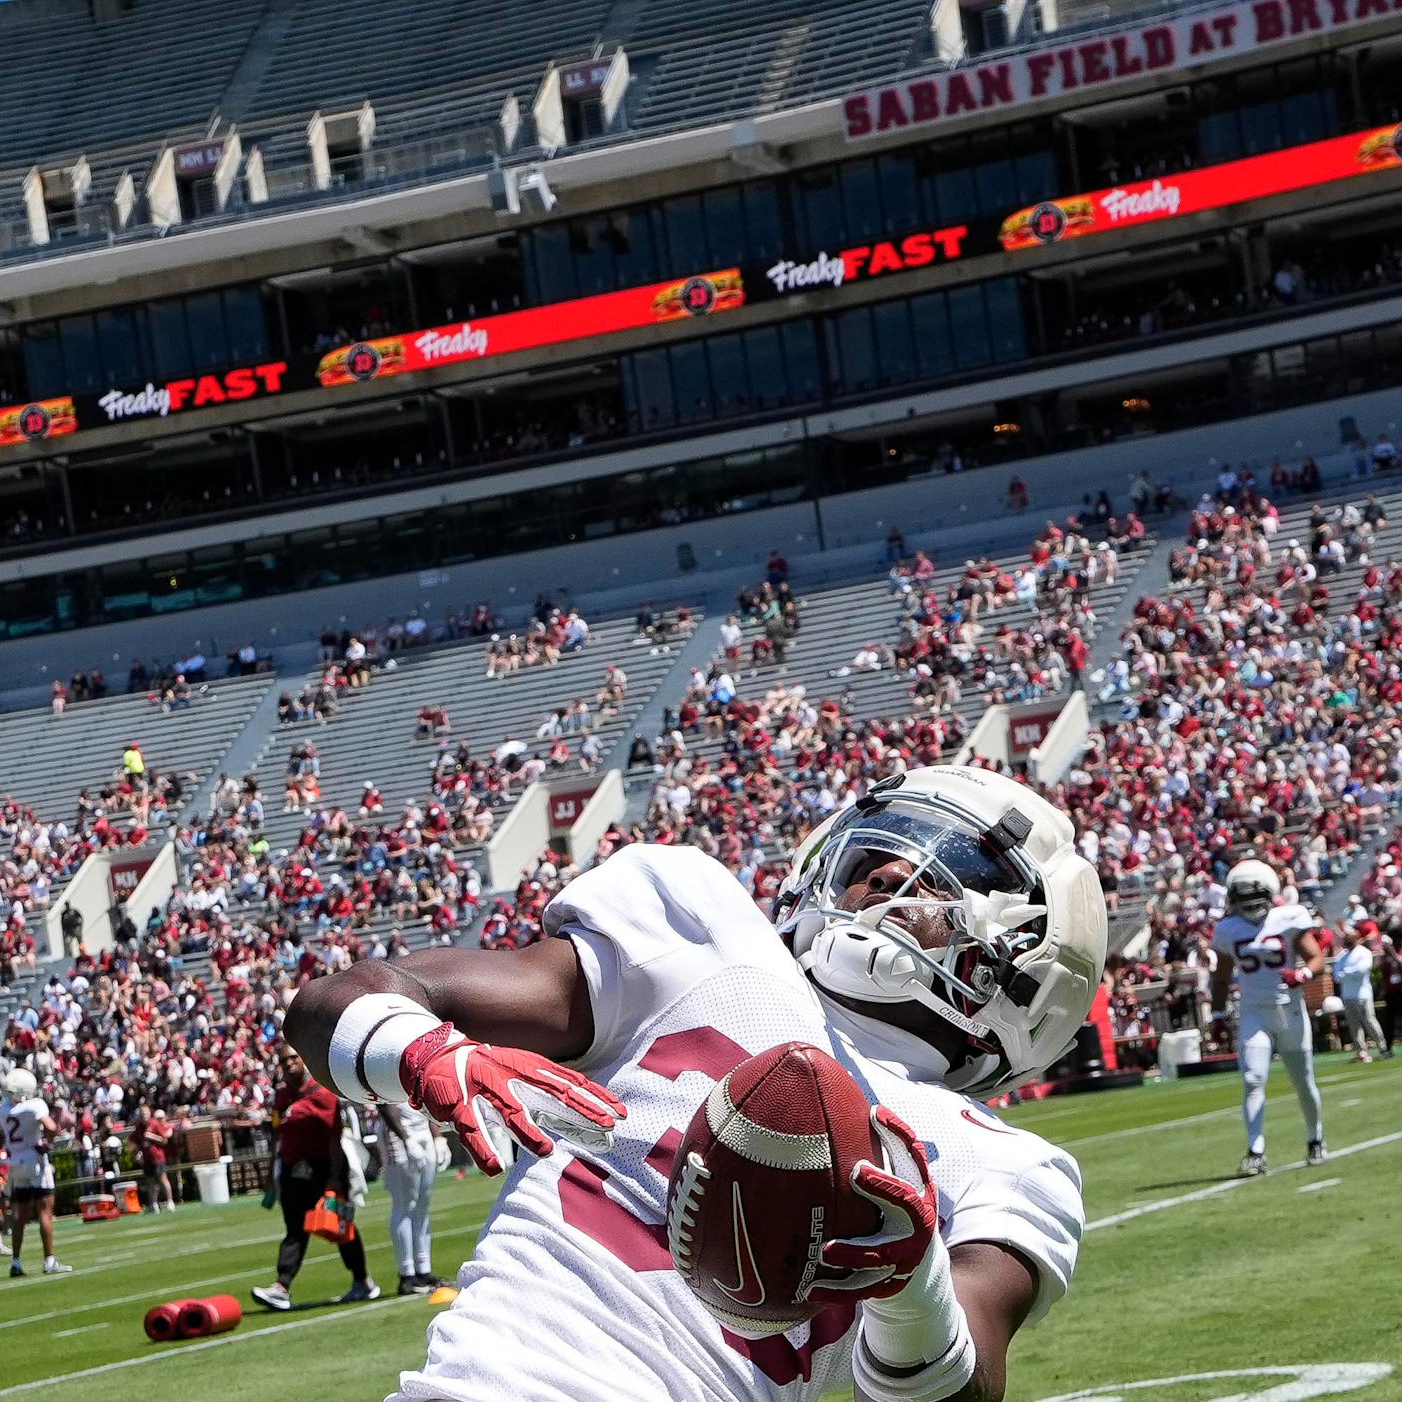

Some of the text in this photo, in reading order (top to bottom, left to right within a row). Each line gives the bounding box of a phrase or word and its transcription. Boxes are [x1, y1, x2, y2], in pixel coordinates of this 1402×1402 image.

[845, 62, 1014, 137] SABAN
[1027, 25, 1175, 97] FIELD
[1190, 15, 1238, 55] AT
[1100, 180, 1171, 222] Freaky
[415, 323, 488, 362] Freaky
[939, 1006, 982, 1034] CRIMSON
[808, 1206, 825, 1260] ELITE
